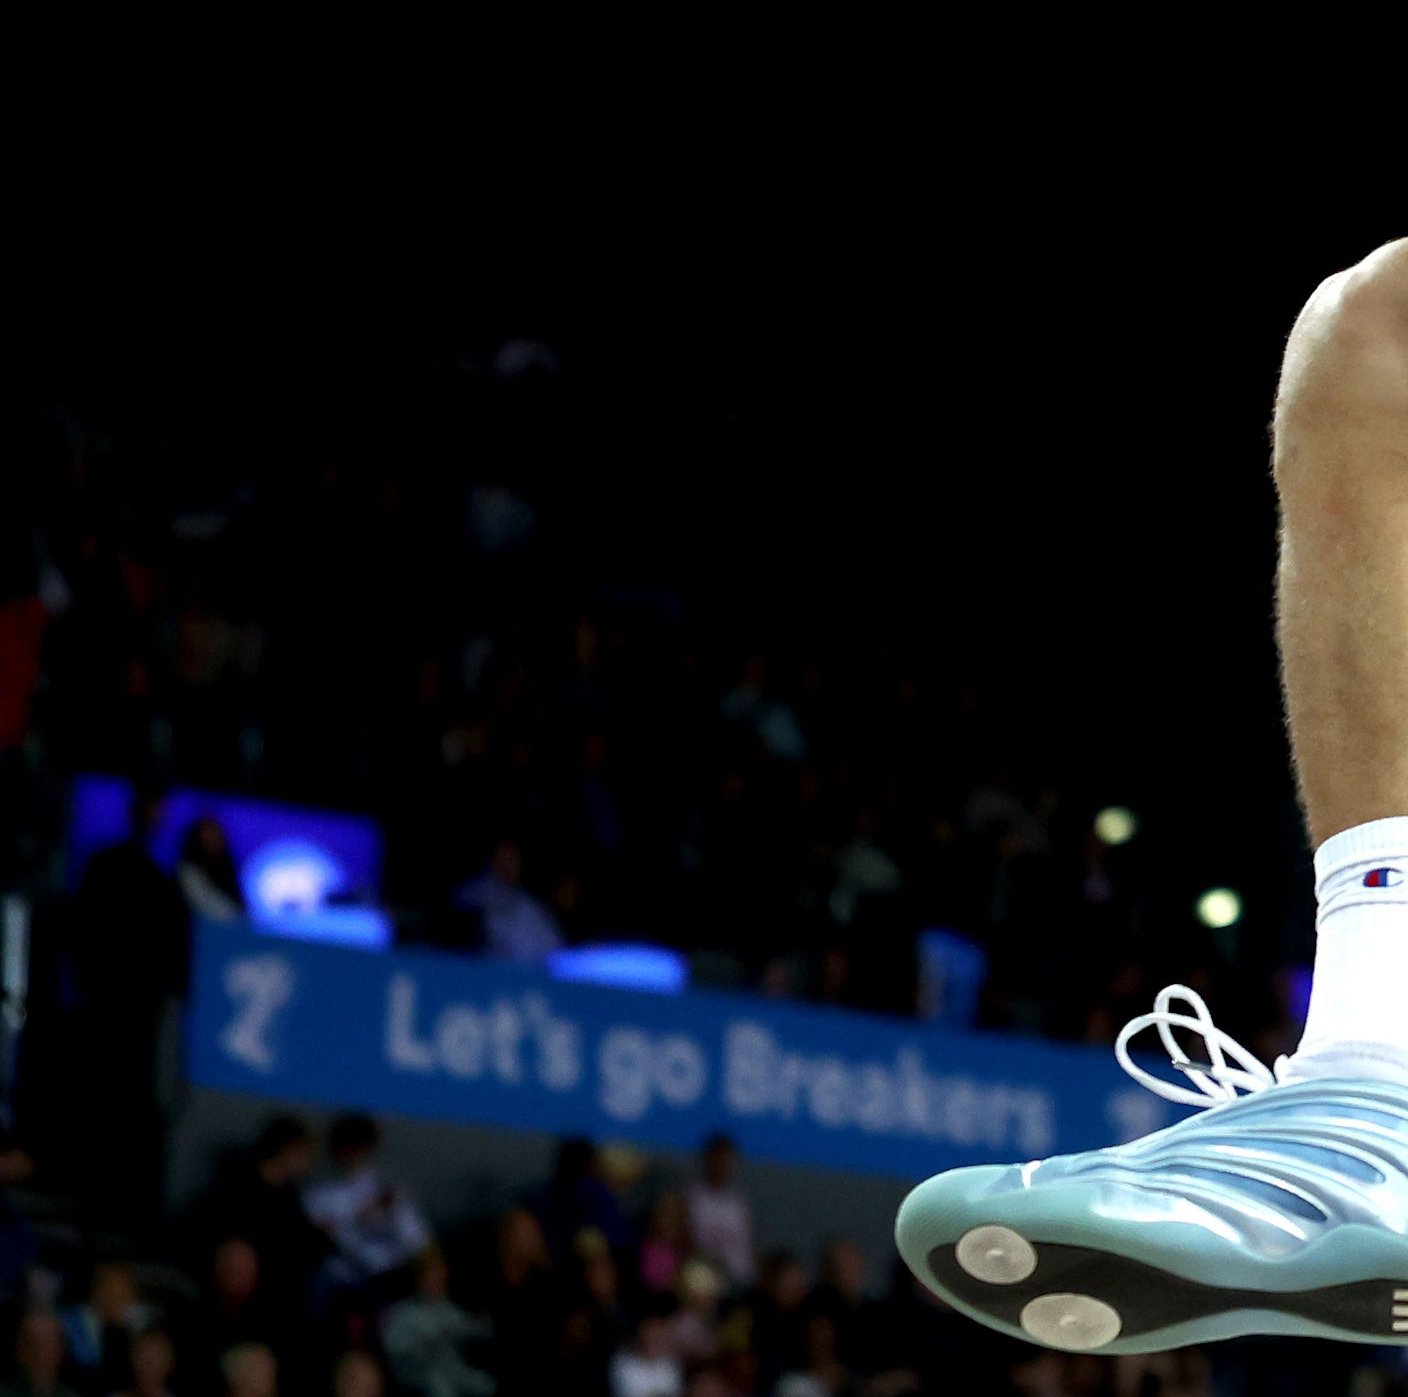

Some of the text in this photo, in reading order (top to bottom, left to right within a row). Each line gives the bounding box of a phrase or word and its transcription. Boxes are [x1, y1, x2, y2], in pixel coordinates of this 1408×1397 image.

[382, 974, 584, 1093] Let's
[601, 1023, 707, 1123] go
[723, 1016, 1056, 1155] Breakers
